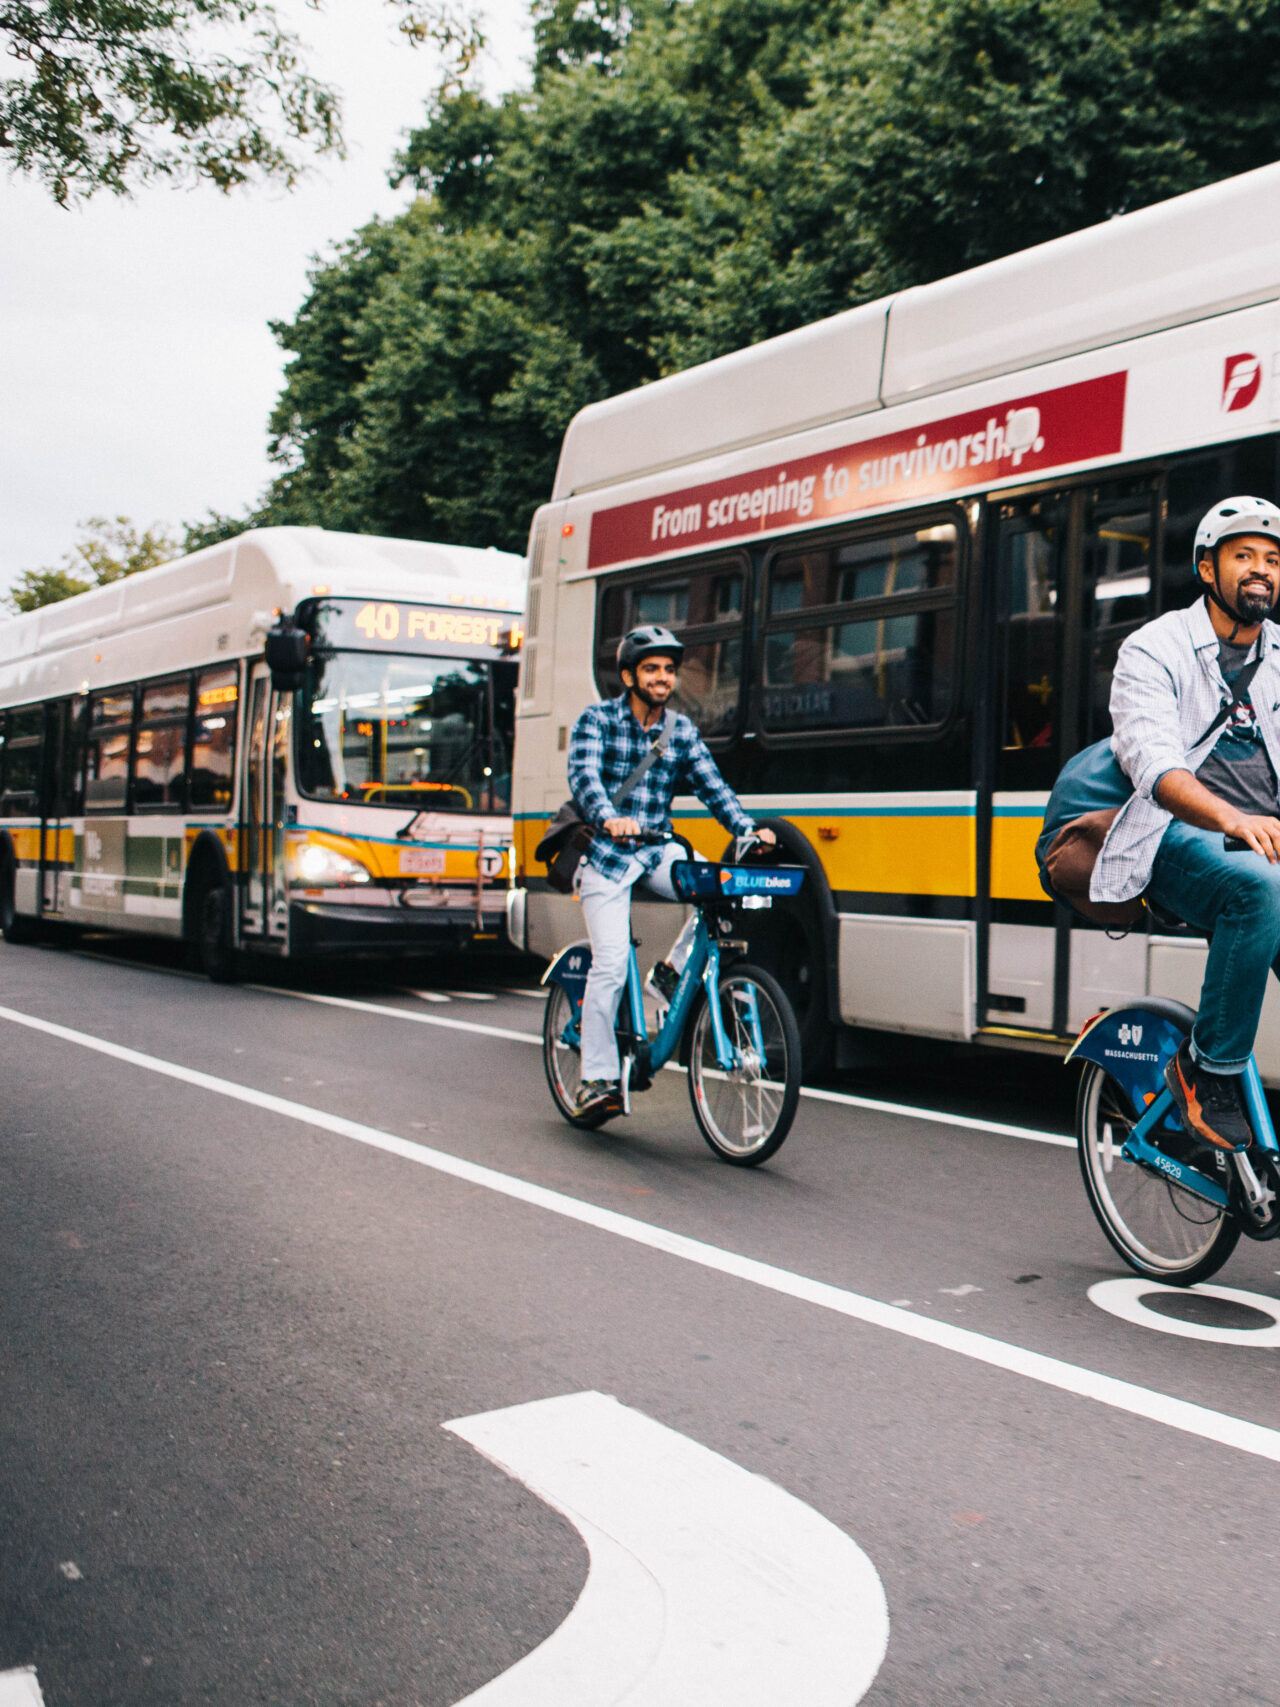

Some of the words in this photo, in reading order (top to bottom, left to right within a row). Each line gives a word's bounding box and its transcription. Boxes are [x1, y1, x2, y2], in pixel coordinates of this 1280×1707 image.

[651, 503, 701, 541] From
[707, 471, 814, 528] screening
[823, 463, 849, 499] to
[355, 603, 400, 640] 40
[407, 610, 503, 645] FOREST
[483, 856, 498, 872] T
[1104, 1048, 1159, 1062] MASSACHUSETTS
[1154, 1155, 1182, 1179] 45829
